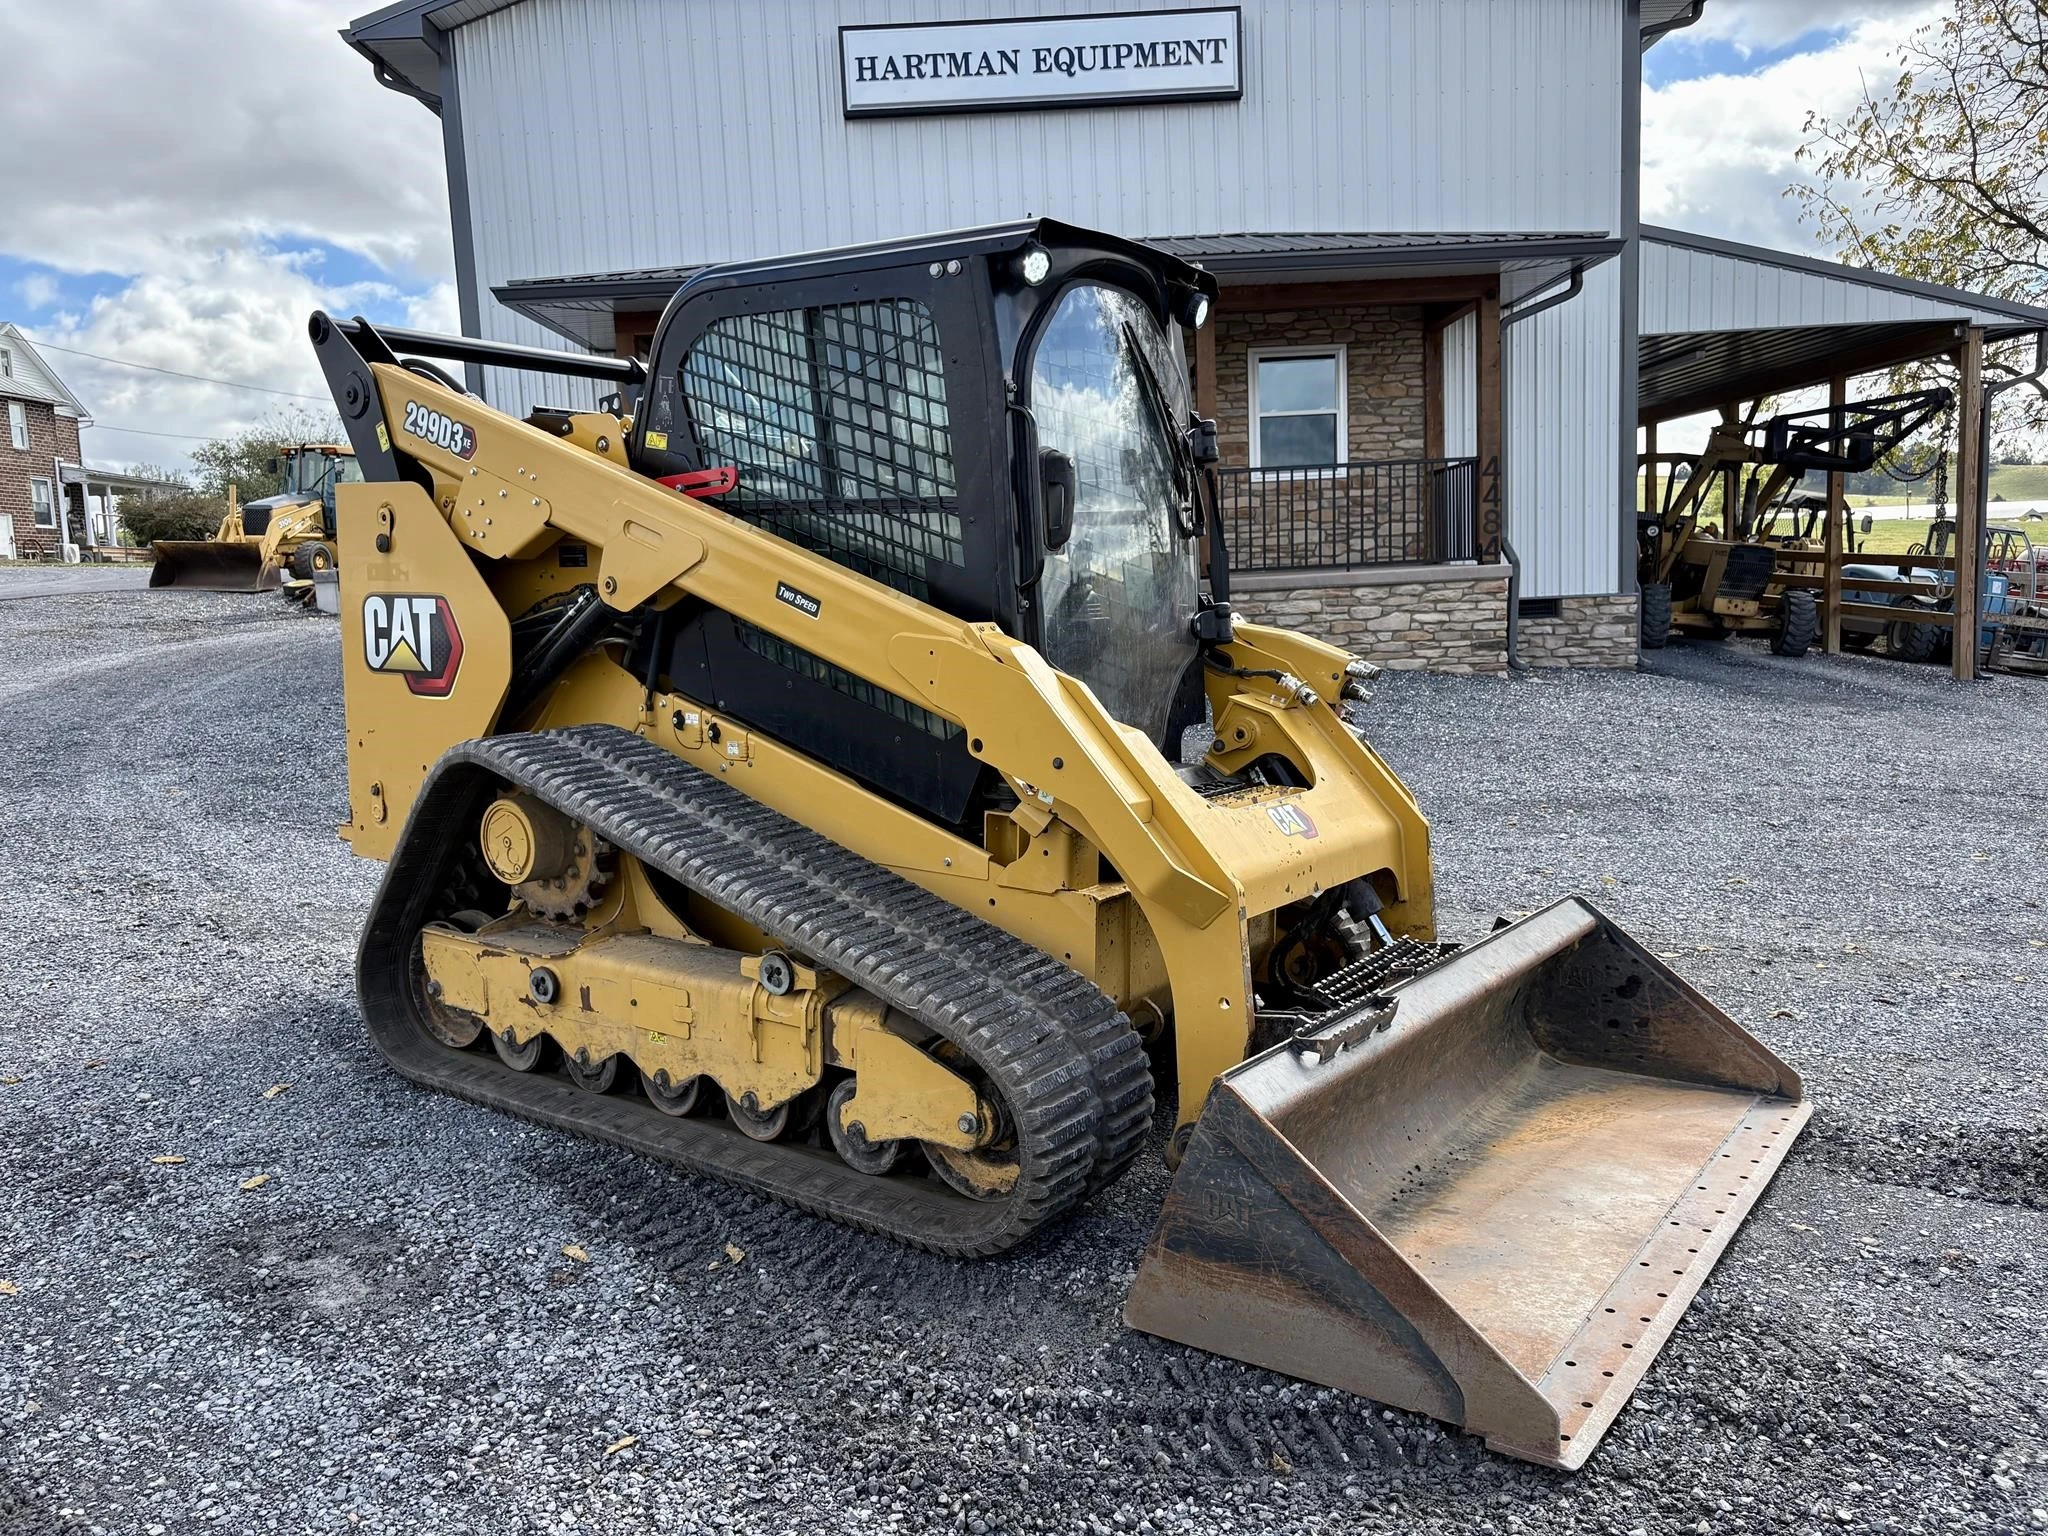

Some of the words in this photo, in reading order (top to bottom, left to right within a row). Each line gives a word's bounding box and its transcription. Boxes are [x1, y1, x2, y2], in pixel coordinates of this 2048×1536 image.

[855, 48, 1020, 82] HARTMAN
[1032, 38, 1228, 77] EQUIPMENT
[403, 401, 464, 454] 299D3
[1481, 455, 1501, 563] 4484
[364, 596, 437, 672] CAT
[1266, 804, 1308, 836] CAT
[1201, 1184, 1253, 1233] CAT
